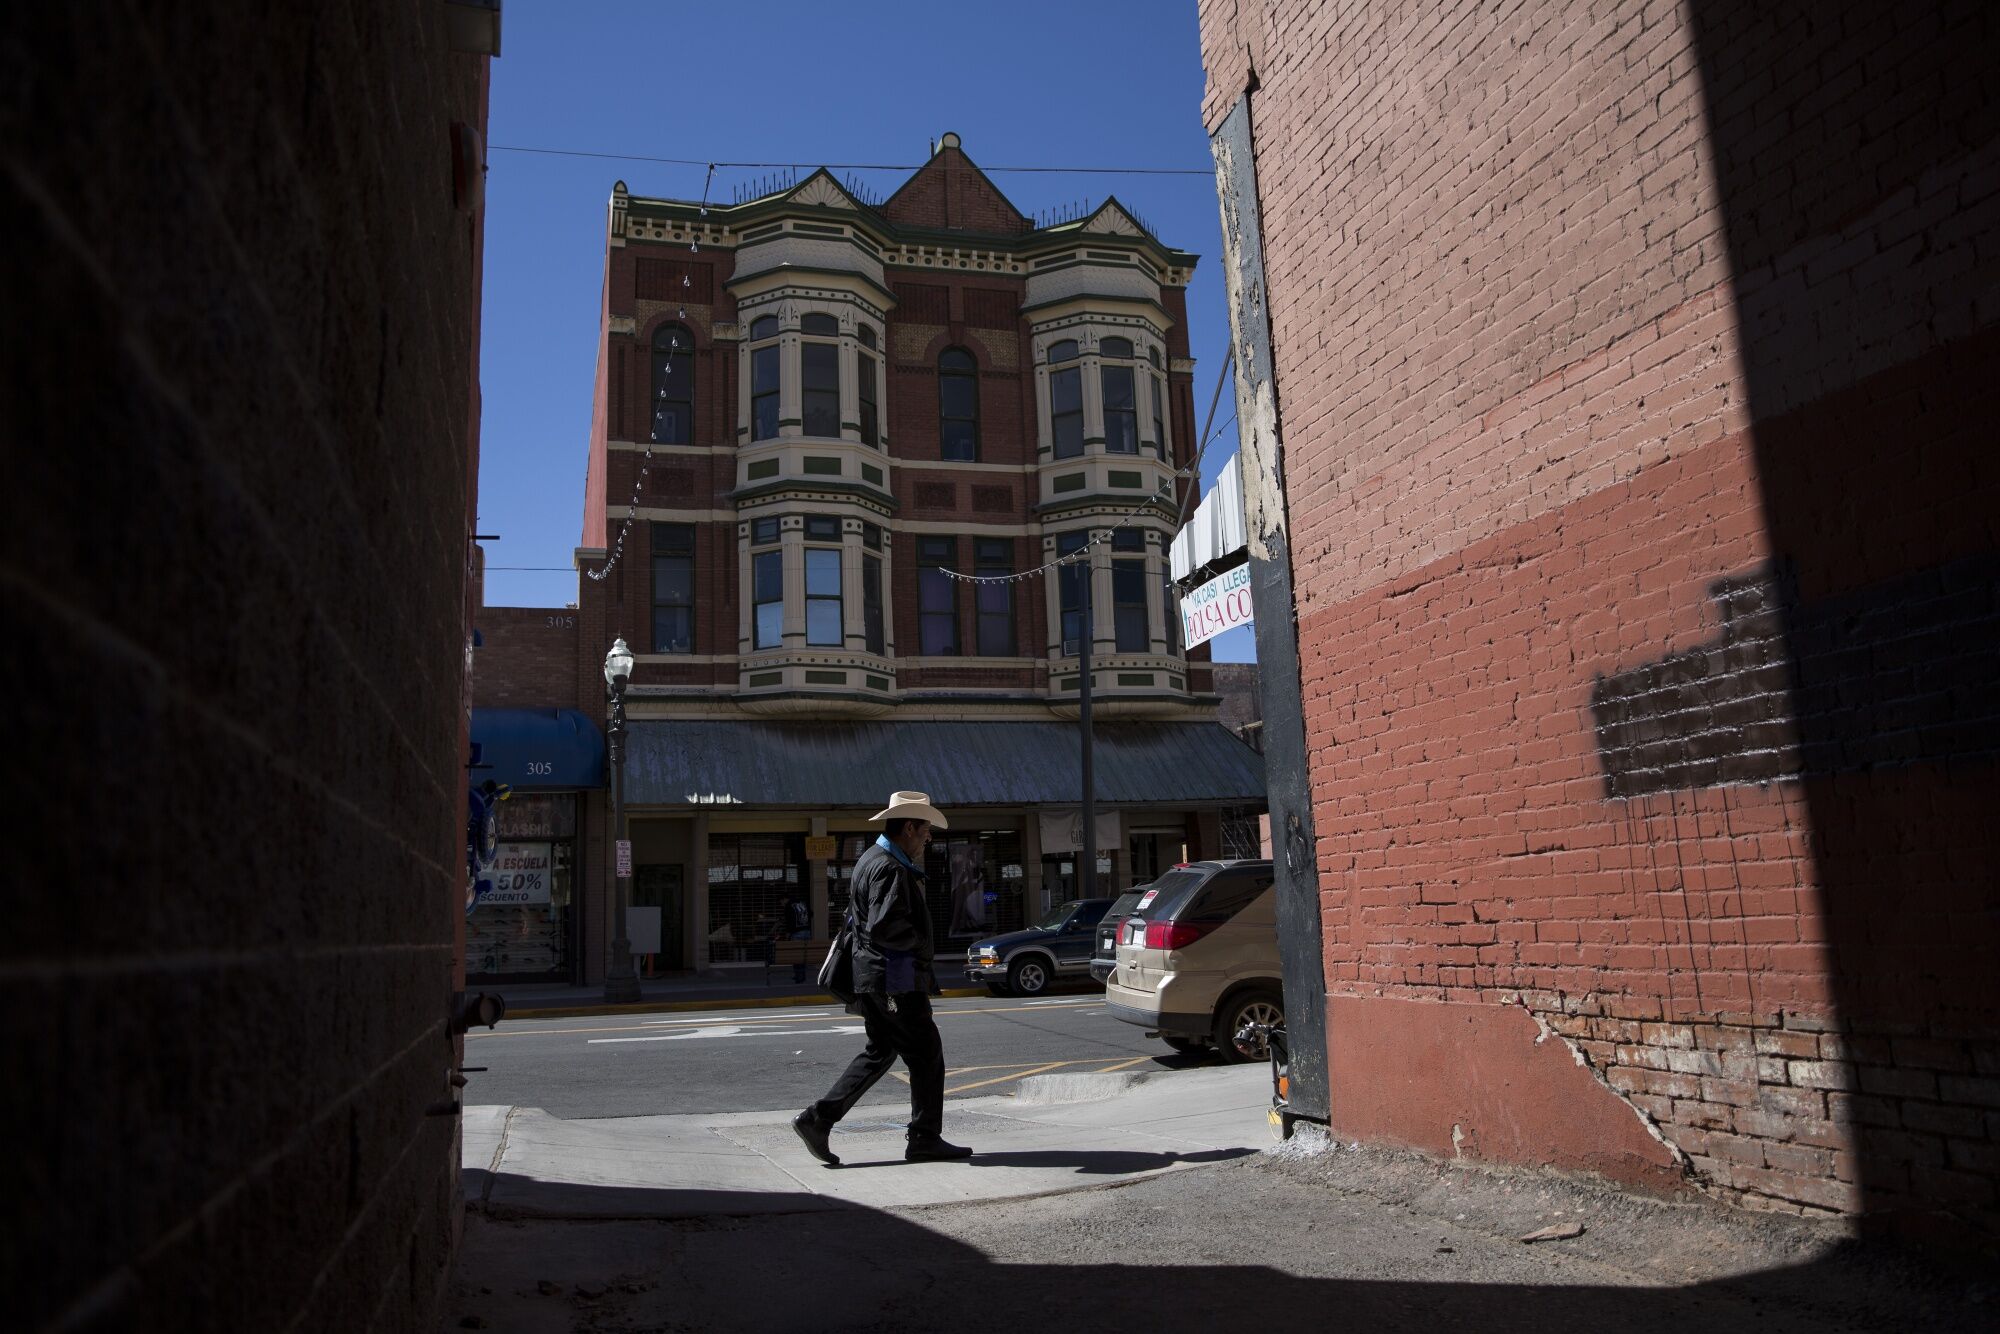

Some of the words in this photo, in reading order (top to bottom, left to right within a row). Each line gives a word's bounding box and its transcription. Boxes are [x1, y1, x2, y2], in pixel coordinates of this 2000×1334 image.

[1202, 581, 1217, 603] CASI
[1188, 600, 1225, 643] BOLSA
[1226, 586, 1253, 622] CO
[545, 616, 573, 629] 305
[526, 762, 552, 775] 305
[492, 858, 500, 870] A
[503, 857, 548, 869] ESCUELA
[497, 873, 542, 890] 50%
[480, 893, 529, 901] SCUENTO
